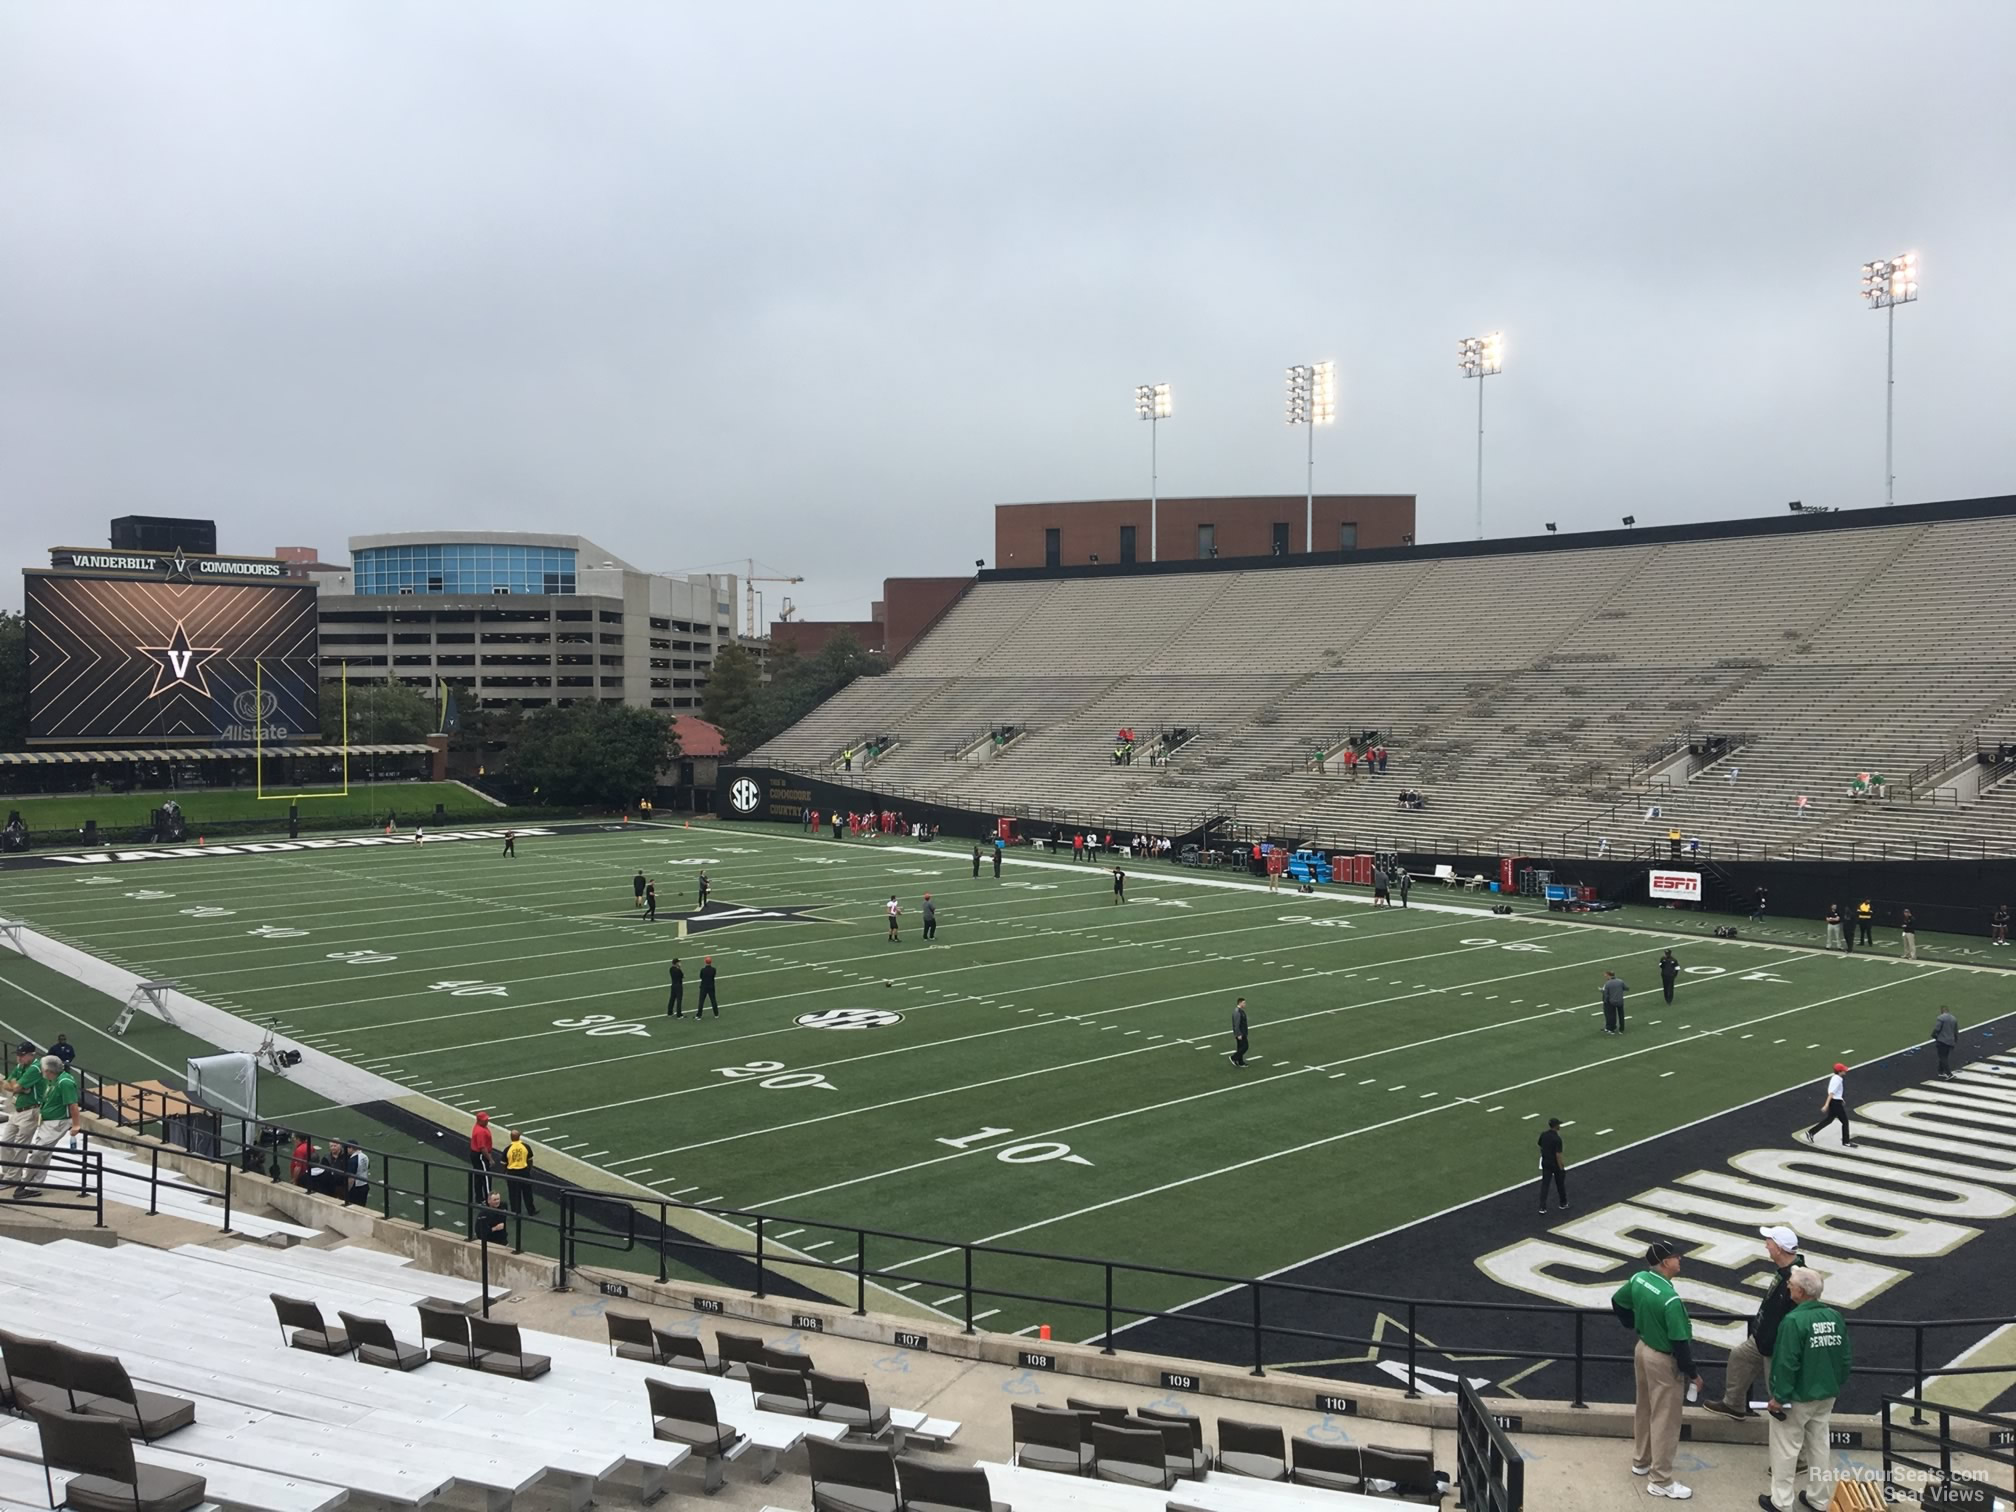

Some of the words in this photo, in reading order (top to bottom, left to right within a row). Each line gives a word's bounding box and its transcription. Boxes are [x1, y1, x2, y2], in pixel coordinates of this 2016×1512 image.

[72, 555, 156, 570] VANDERBILT
[173, 559, 186, 572] V
[200, 561, 280, 576] COMMODORES
[167, 650, 192, 678] V
[221, 724, 287, 740] Allstate
[732, 779, 758, 811] SEC
[769, 788, 811, 801] COMMODORE
[769, 804, 802, 817] COUNTRY
[43, 828, 558, 863] VANDERBILT
[1653, 876, 1697, 891] ESPN
[326, 949, 398, 965] 50
[427, 980, 507, 997] 40
[552, 1014, 647, 1036] 30
[710, 1061, 826, 1089] 20
[935, 1126, 1071, 1164] 10
[605, 1283, 623, 1296] 104
[702, 1299, 718, 1312] 105
[799, 1316, 816, 1329] 106
[1812, 1321, 1836, 1335] GUEST
[901, 1334, 920, 1346] 107
[1809, 1335, 1842, 1348] SERVCES
[1027, 1354, 1047, 1367] 108
[1169, 1375, 1191, 1388] 109
[1324, 1398, 1346, 1411] 110
[1830, 1432, 1850, 1443] 113
